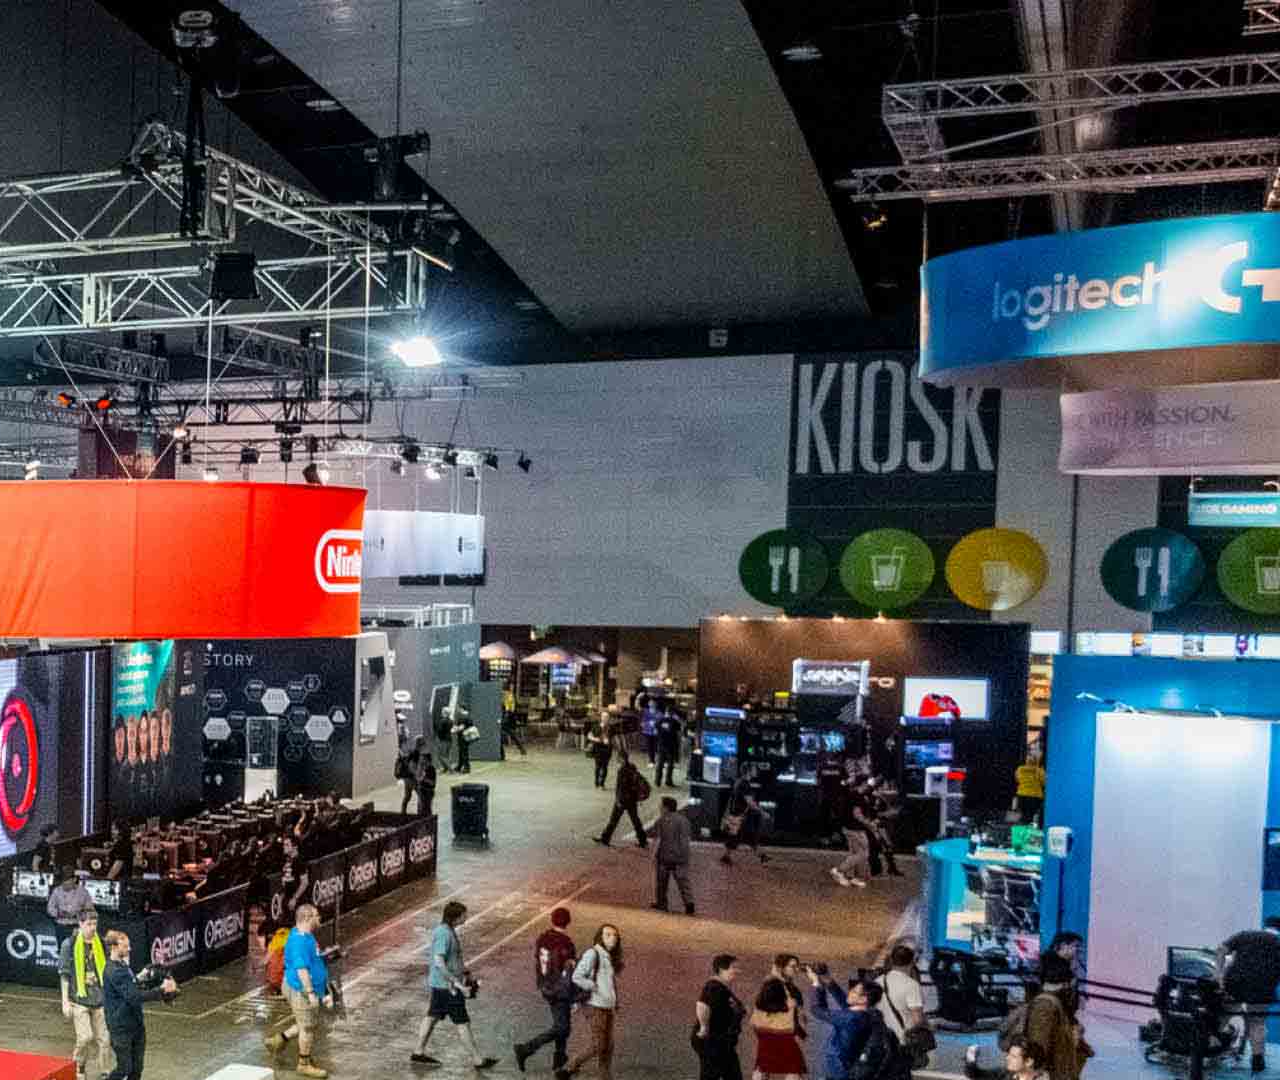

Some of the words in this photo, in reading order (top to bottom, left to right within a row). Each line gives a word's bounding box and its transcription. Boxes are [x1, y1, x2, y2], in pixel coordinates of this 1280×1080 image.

[992, 262, 1168, 331] logitech
[795, 360, 995, 474] KIOSK
[151, 927, 196, 966] ORIGIN
